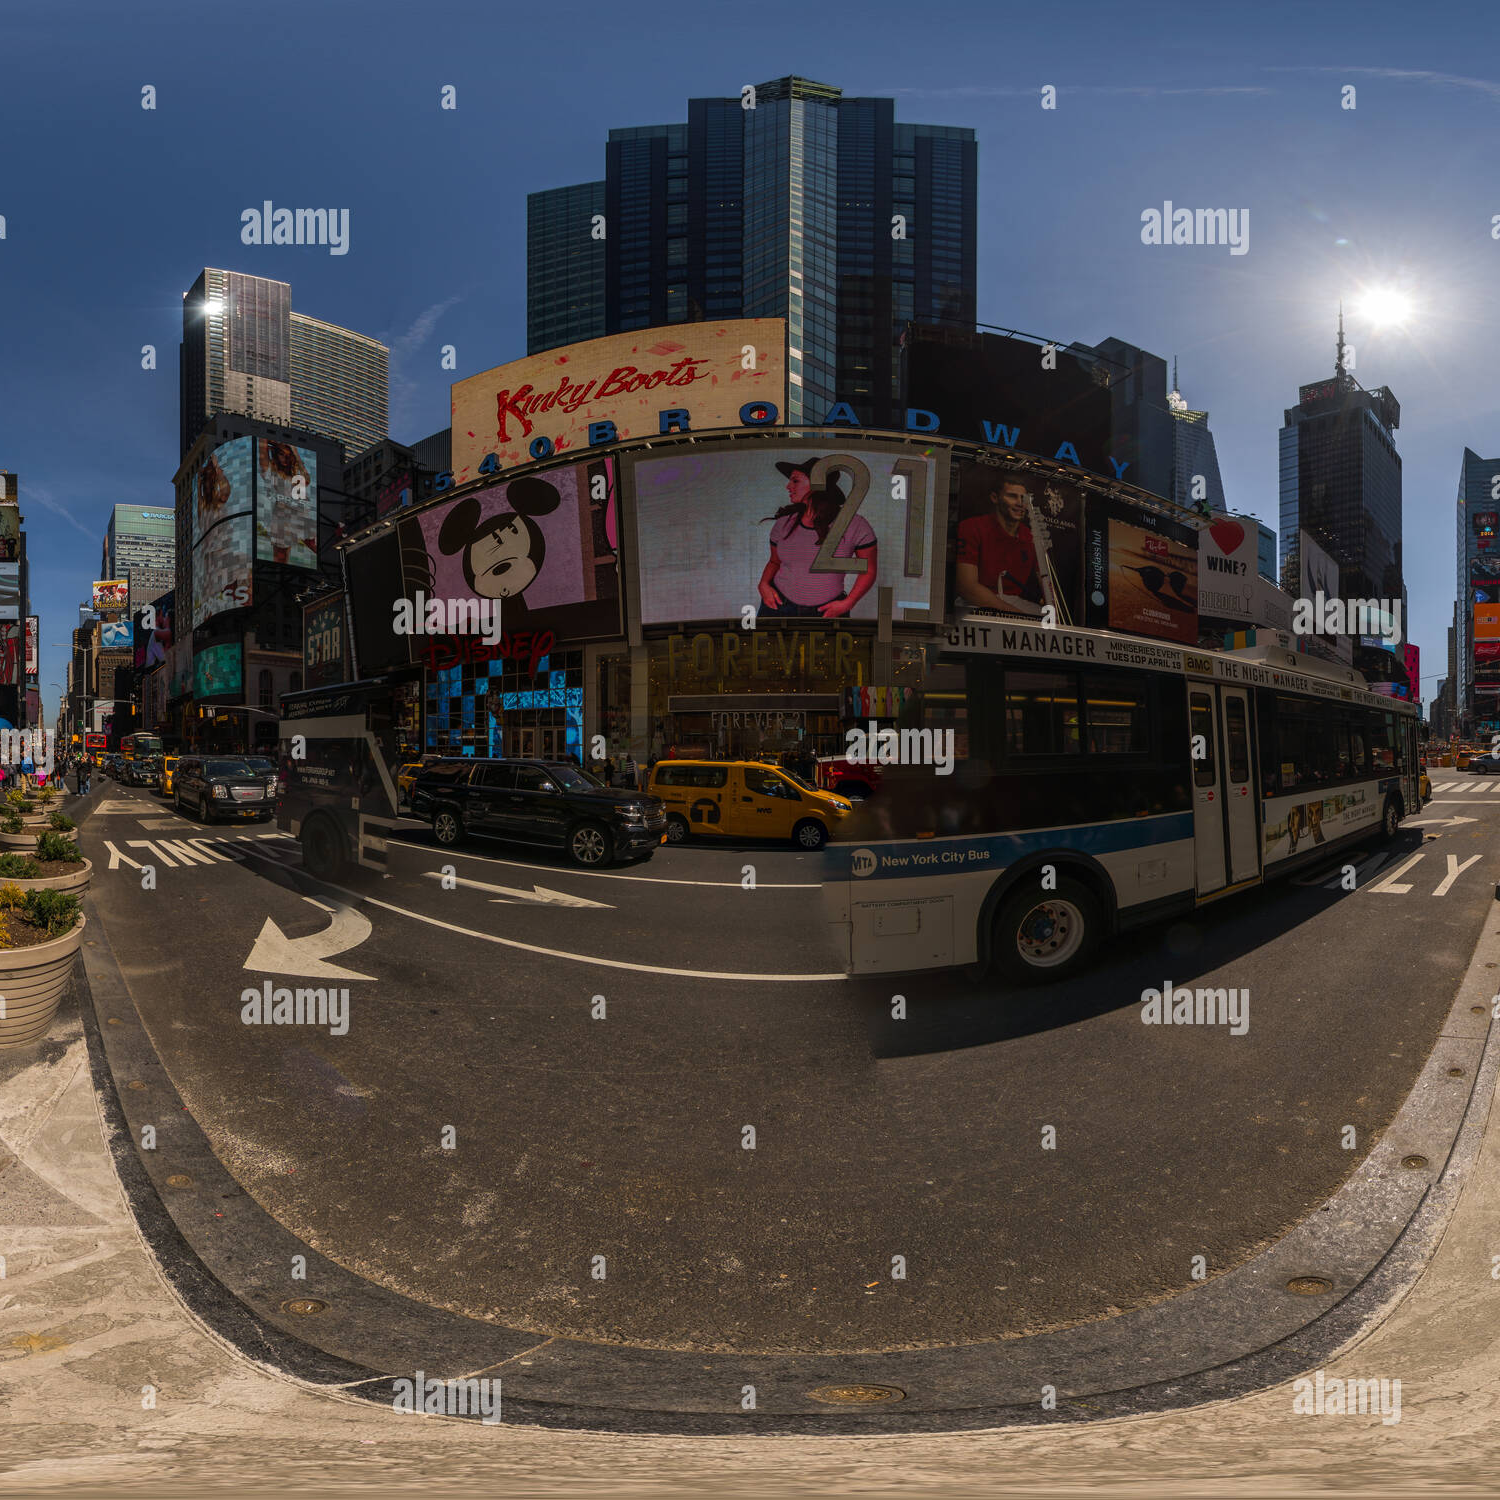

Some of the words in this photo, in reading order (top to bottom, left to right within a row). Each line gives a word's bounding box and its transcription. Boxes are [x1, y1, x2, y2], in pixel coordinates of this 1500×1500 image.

[496, 379, 596, 443] Kinky
[594, 358, 710, 400] Boots
[1206, 554, 1248, 576] WINE?
[307, 627, 341, 666] STAR
[668, 632, 857, 677] FOREVER
[1002, 629, 1096, 657] MANAGER
[1110, 641, 1156, 656] MINISERIES
[1156, 648, 1181, 659] EVENT
[1105, 651, 1130, 662] TUES
[1148, 656, 1171, 668] APRIL
[1172, 660, 1182, 669] 19
[1218, 660, 1238, 678] THE
[1241, 664, 1269, 683] NIGHT
[1272, 673, 1309, 692] MANAGER
[710, 711, 786, 730] FOREVER
[881, 855, 909, 867] New
[911, 852, 938, 865] York
[941, 851, 965, 864] City
[968, 849, 991, 860] Bus
